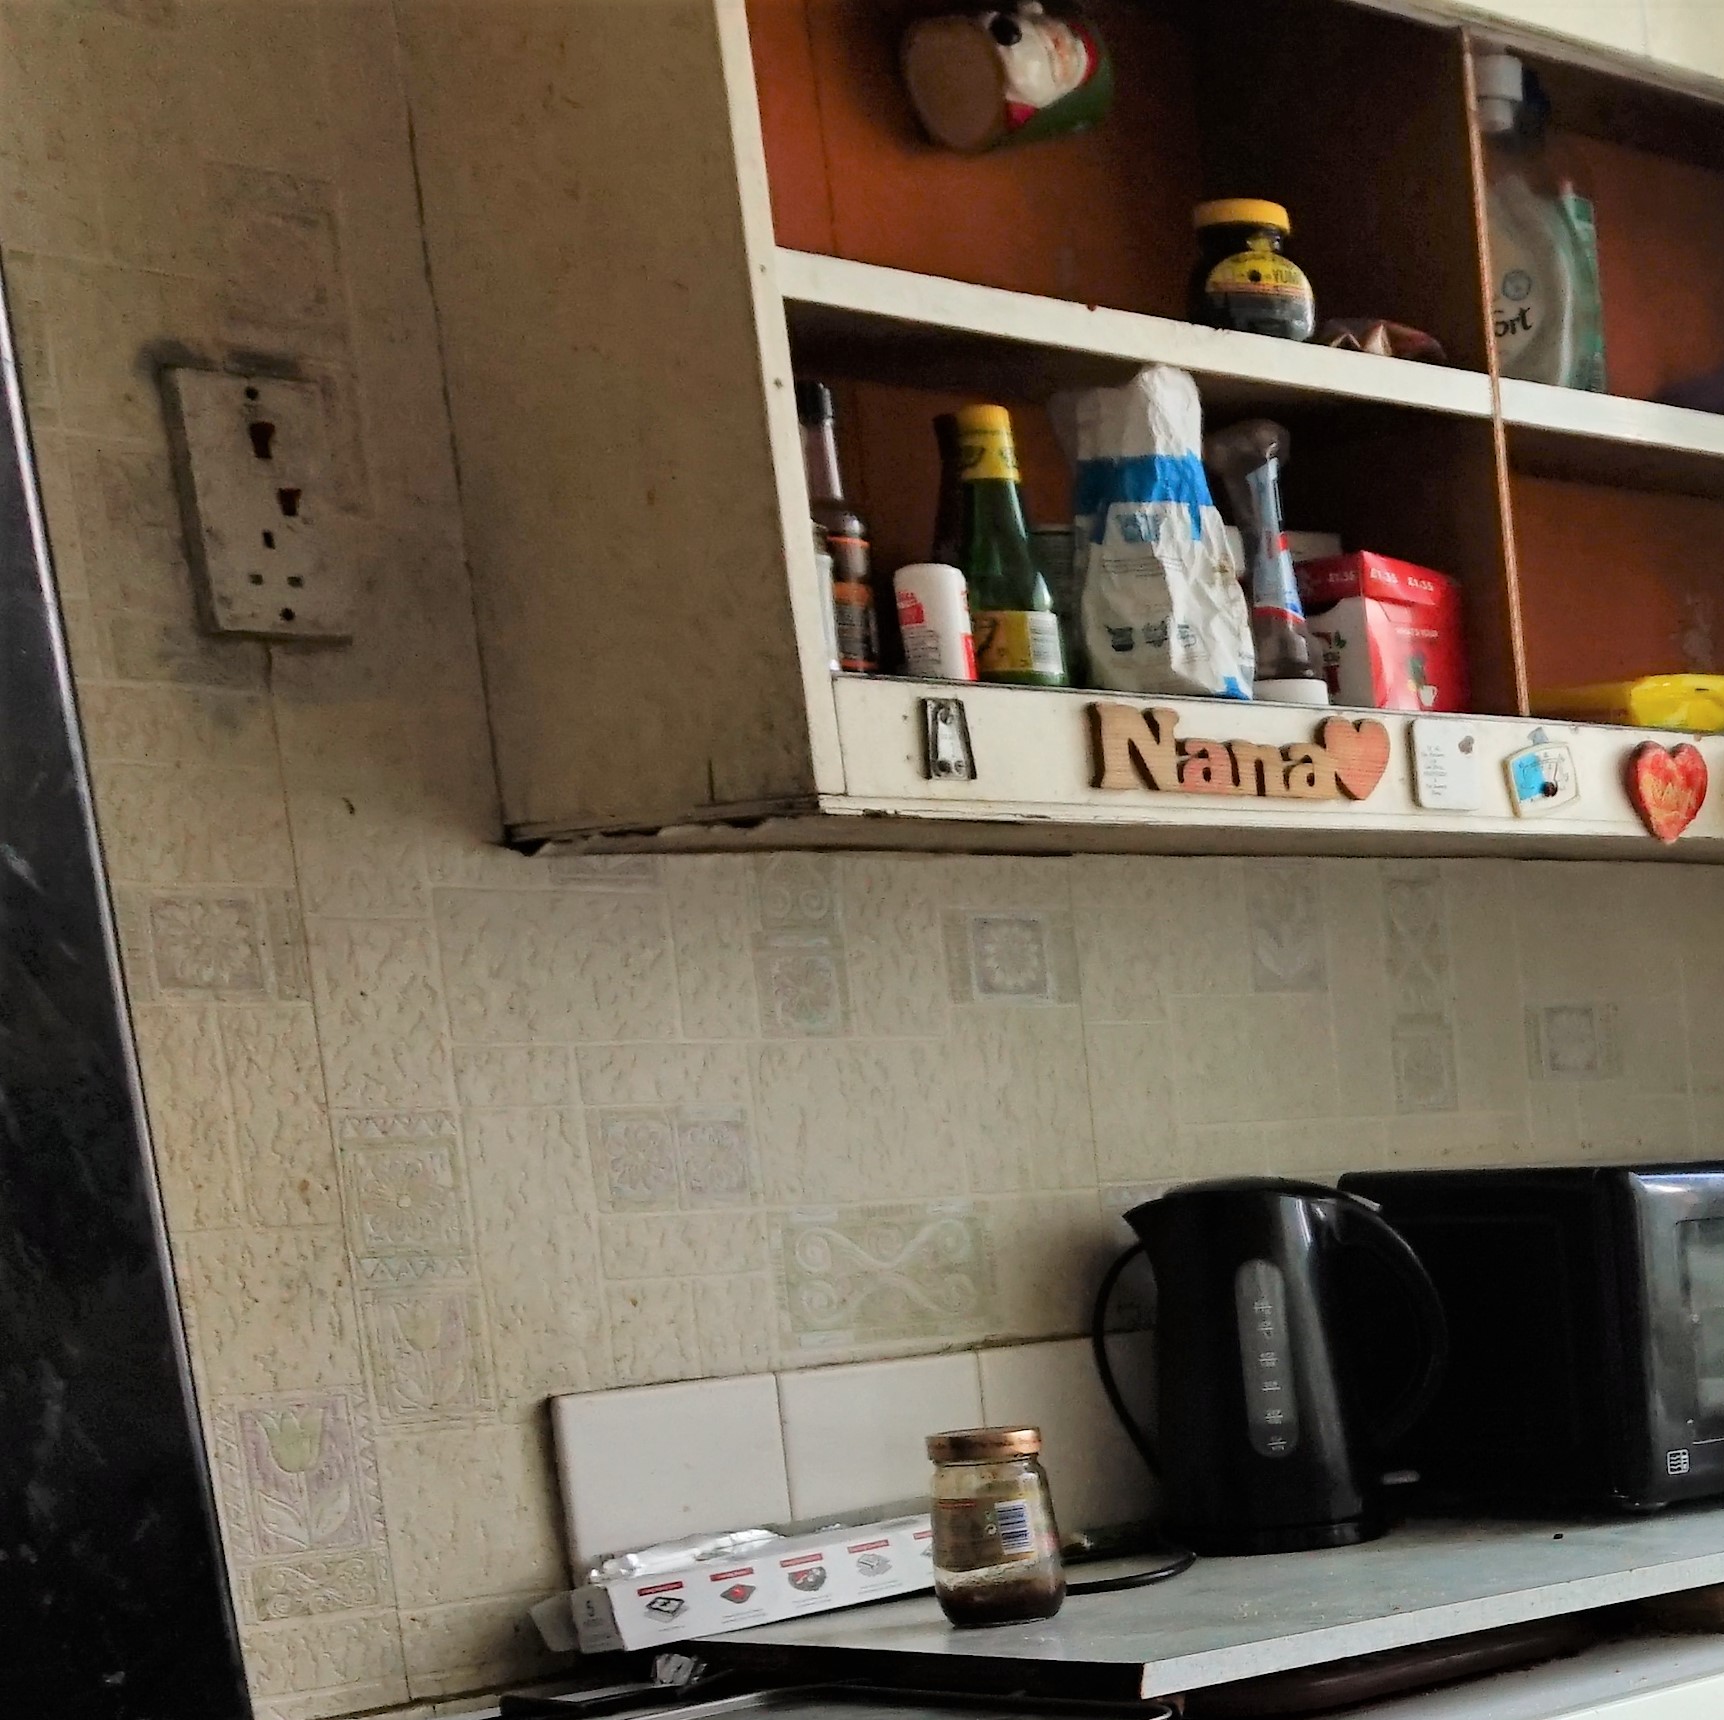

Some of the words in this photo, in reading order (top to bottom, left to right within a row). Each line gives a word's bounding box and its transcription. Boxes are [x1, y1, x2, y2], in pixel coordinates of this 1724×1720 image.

[1370, 567, 1398, 585] £1.35
[1407, 576, 1435, 592] £1.35
[1092, 702, 1336, 799] Nana
